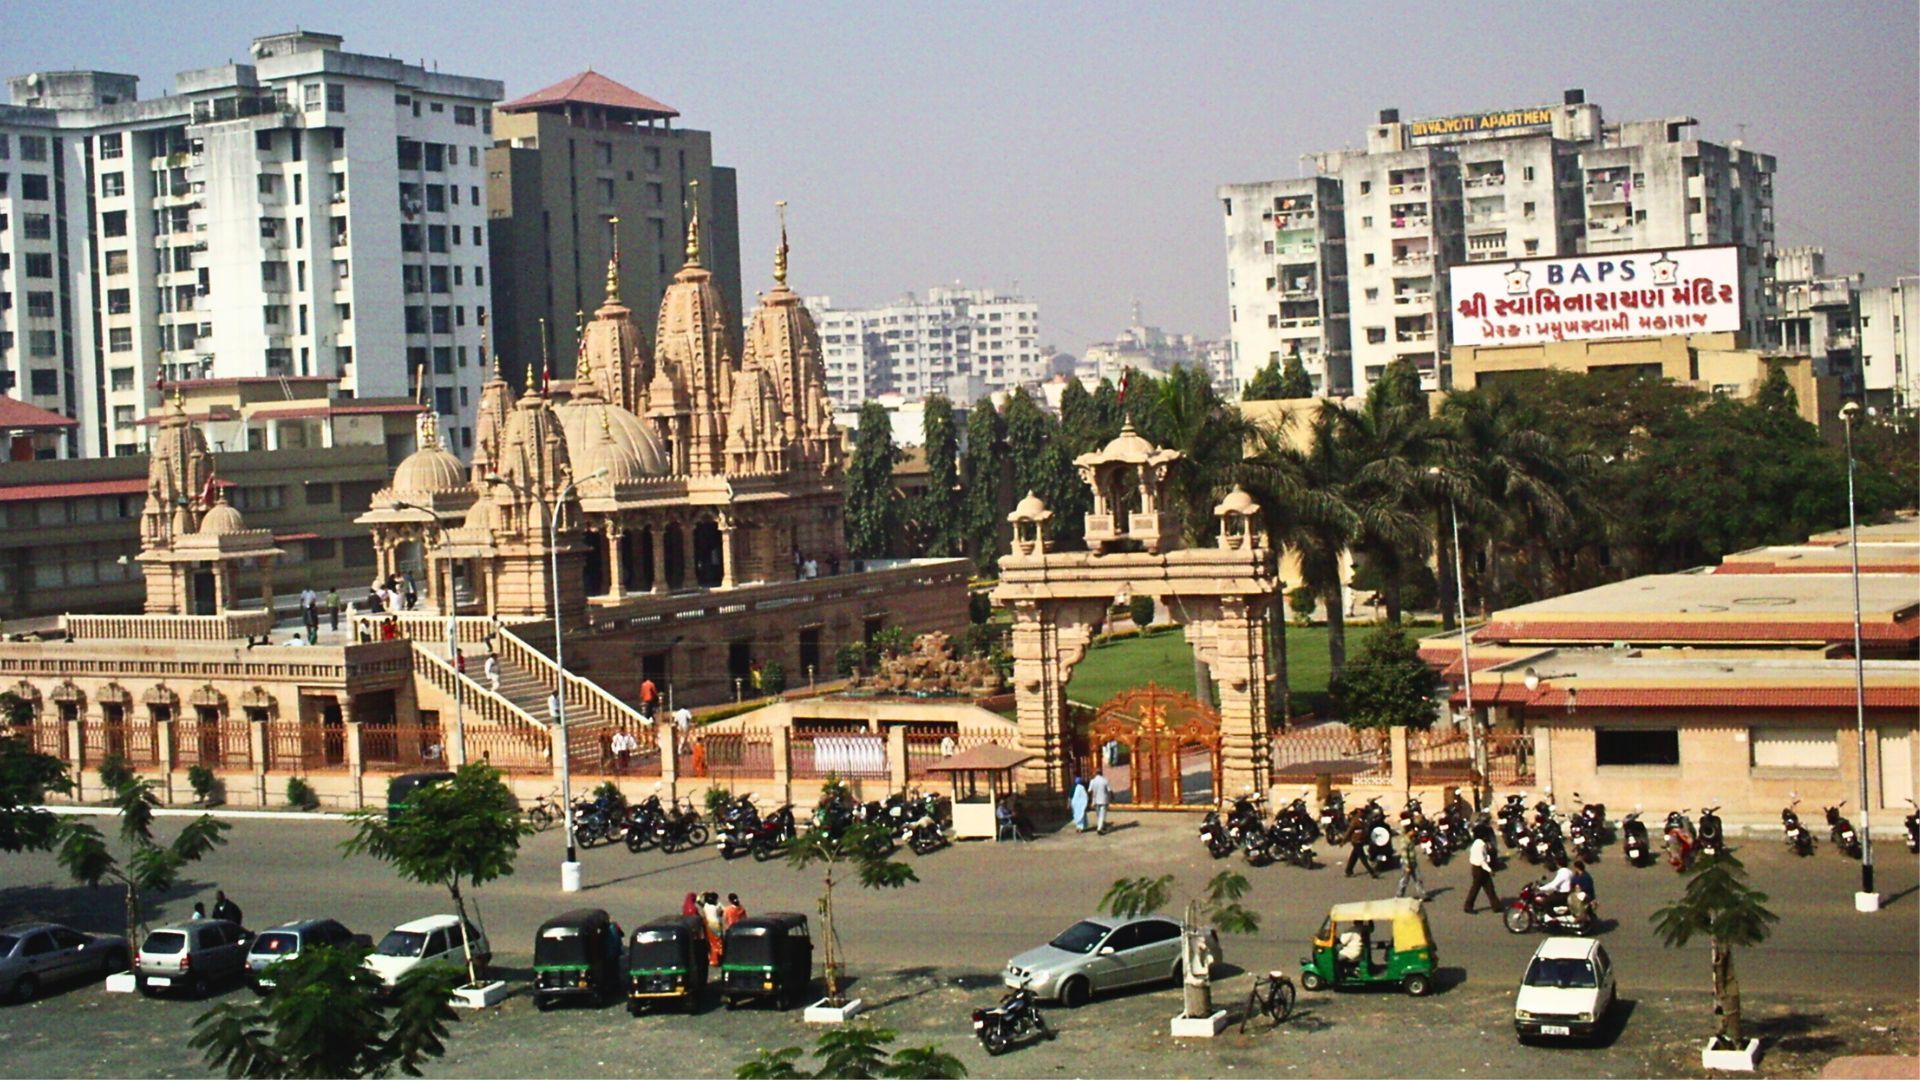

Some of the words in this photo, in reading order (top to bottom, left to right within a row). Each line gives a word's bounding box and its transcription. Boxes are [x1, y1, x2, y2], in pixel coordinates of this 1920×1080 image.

[1547, 259, 1637, 284] BAPS
[1457, 292, 1487, 318] શ્રી
[1494, 287, 1664, 318] સ્વામિનારાયણ
[1672, 278, 1733, 306] મંદિર
[1639, 313, 1708, 330] મહારાજ
